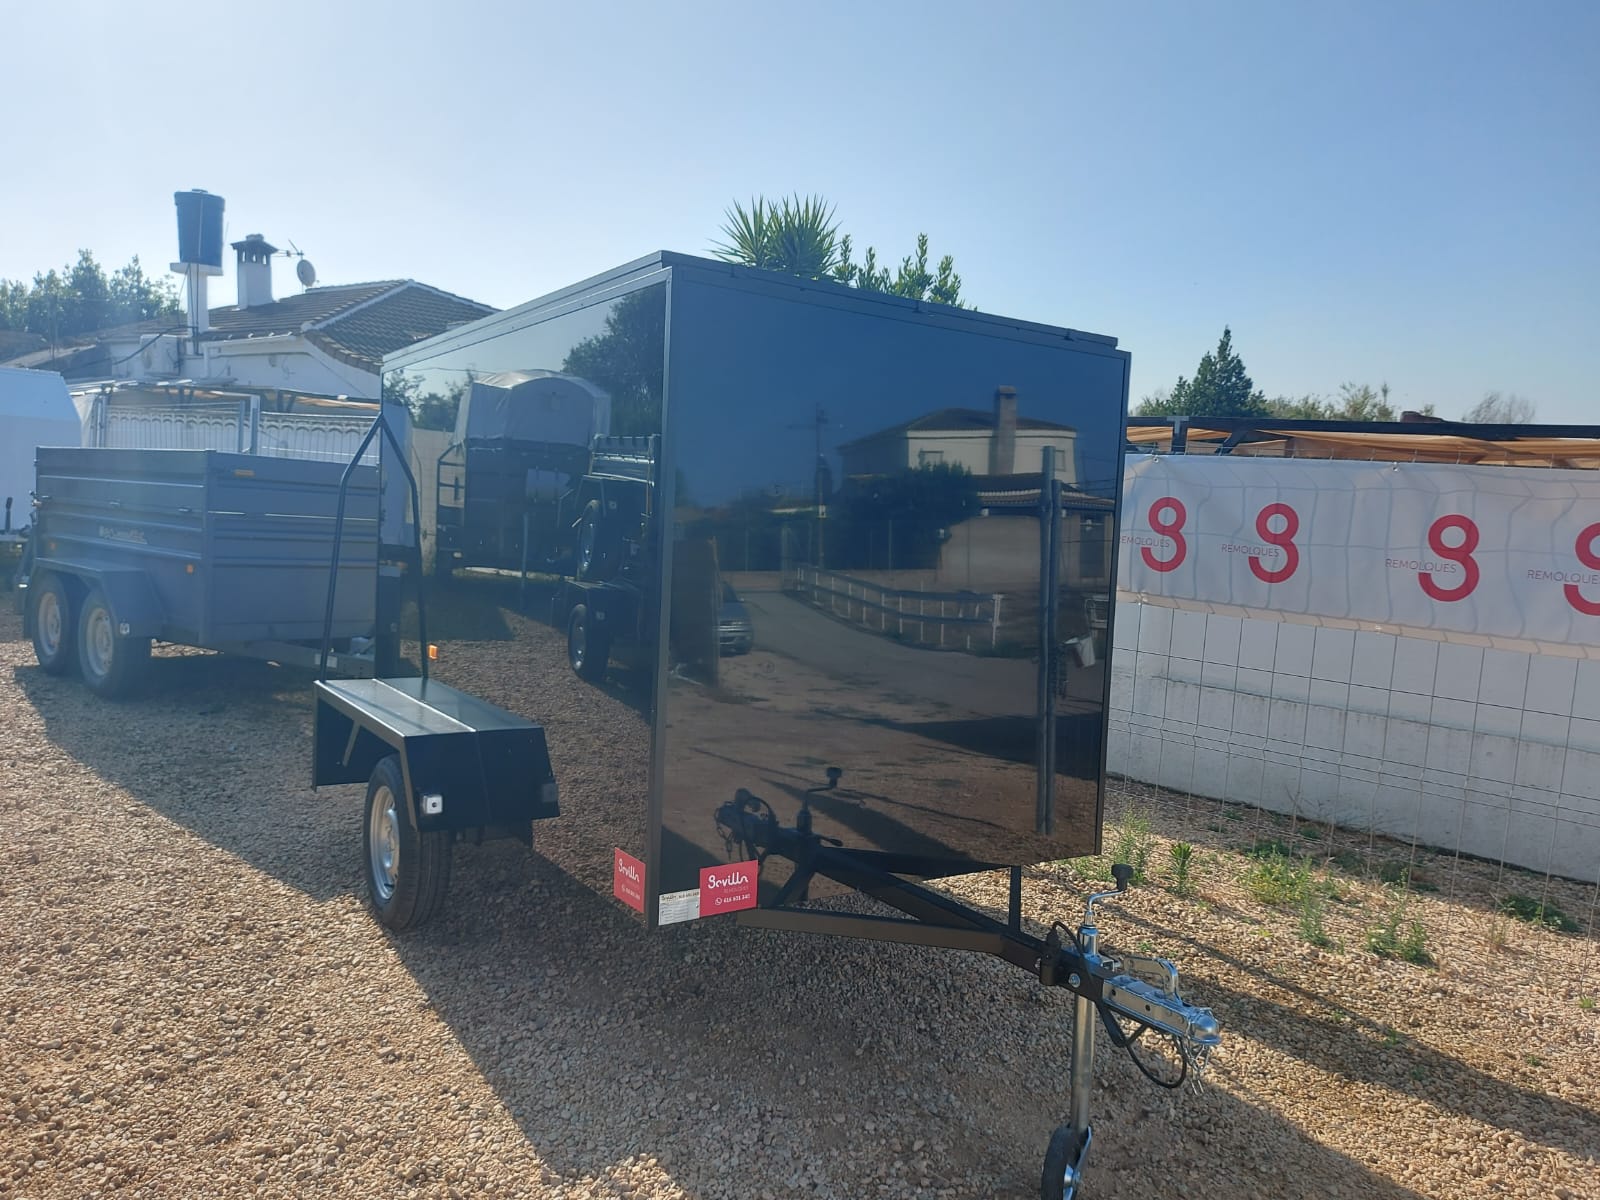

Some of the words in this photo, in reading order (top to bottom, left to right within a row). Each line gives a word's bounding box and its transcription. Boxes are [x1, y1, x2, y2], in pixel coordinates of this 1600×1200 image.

[1120, 535, 1170, 548] EMOLQUES
[1221, 543, 1280, 558] REMOLQUES
[1385, 558, 1457, 573] REMOLQUES
[707, 871, 749, 889] Sevilla
